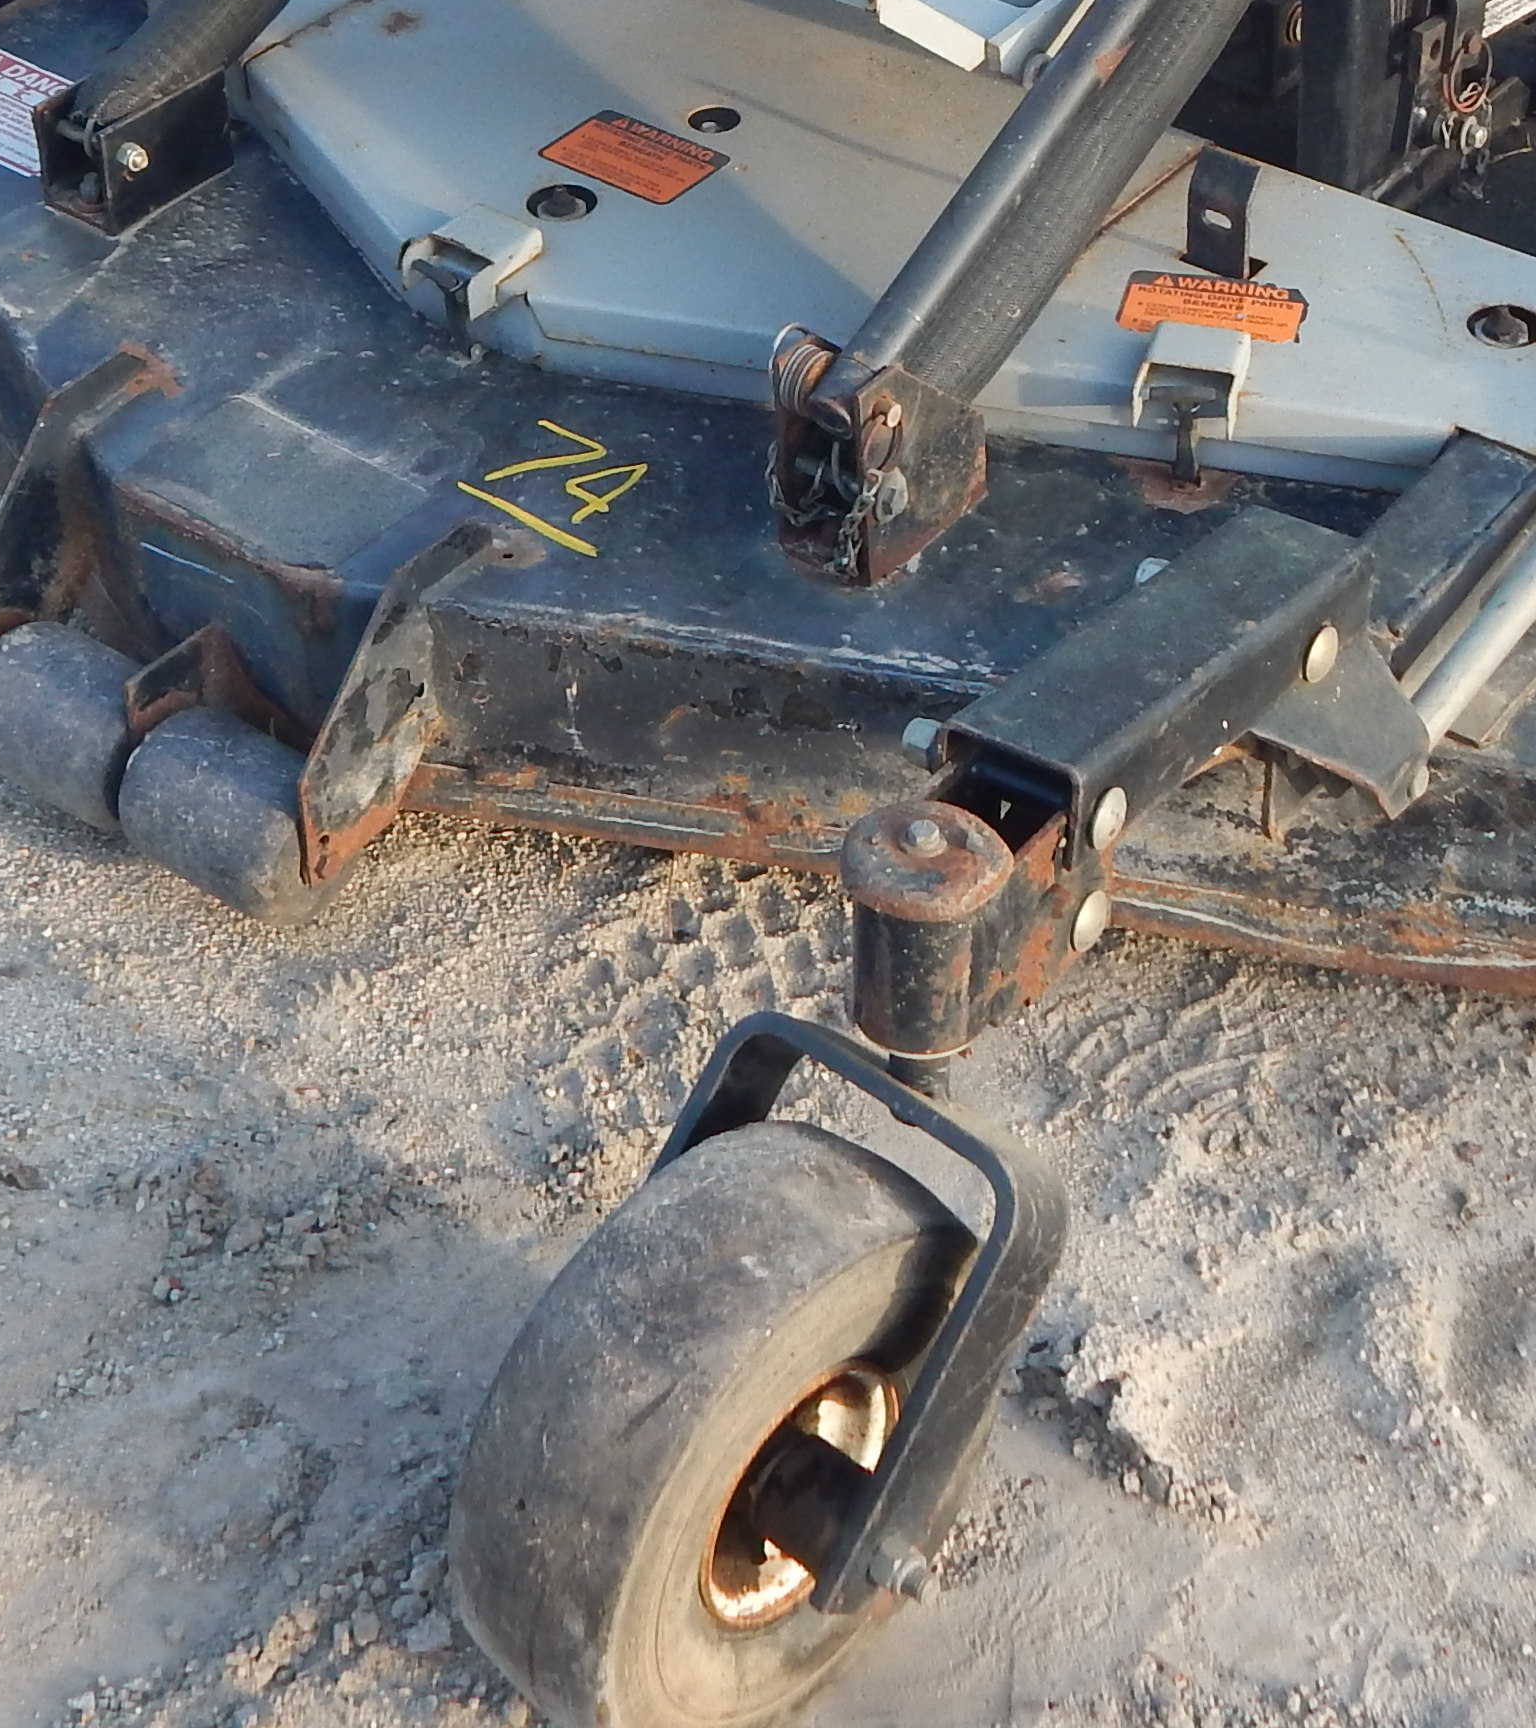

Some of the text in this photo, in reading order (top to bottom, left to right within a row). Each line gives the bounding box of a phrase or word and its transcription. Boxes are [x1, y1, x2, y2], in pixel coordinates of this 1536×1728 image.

[632, 121, 715, 161] WARNING
[1175, 276, 1289, 299] WARNING
[483, 418, 649, 524] 74
